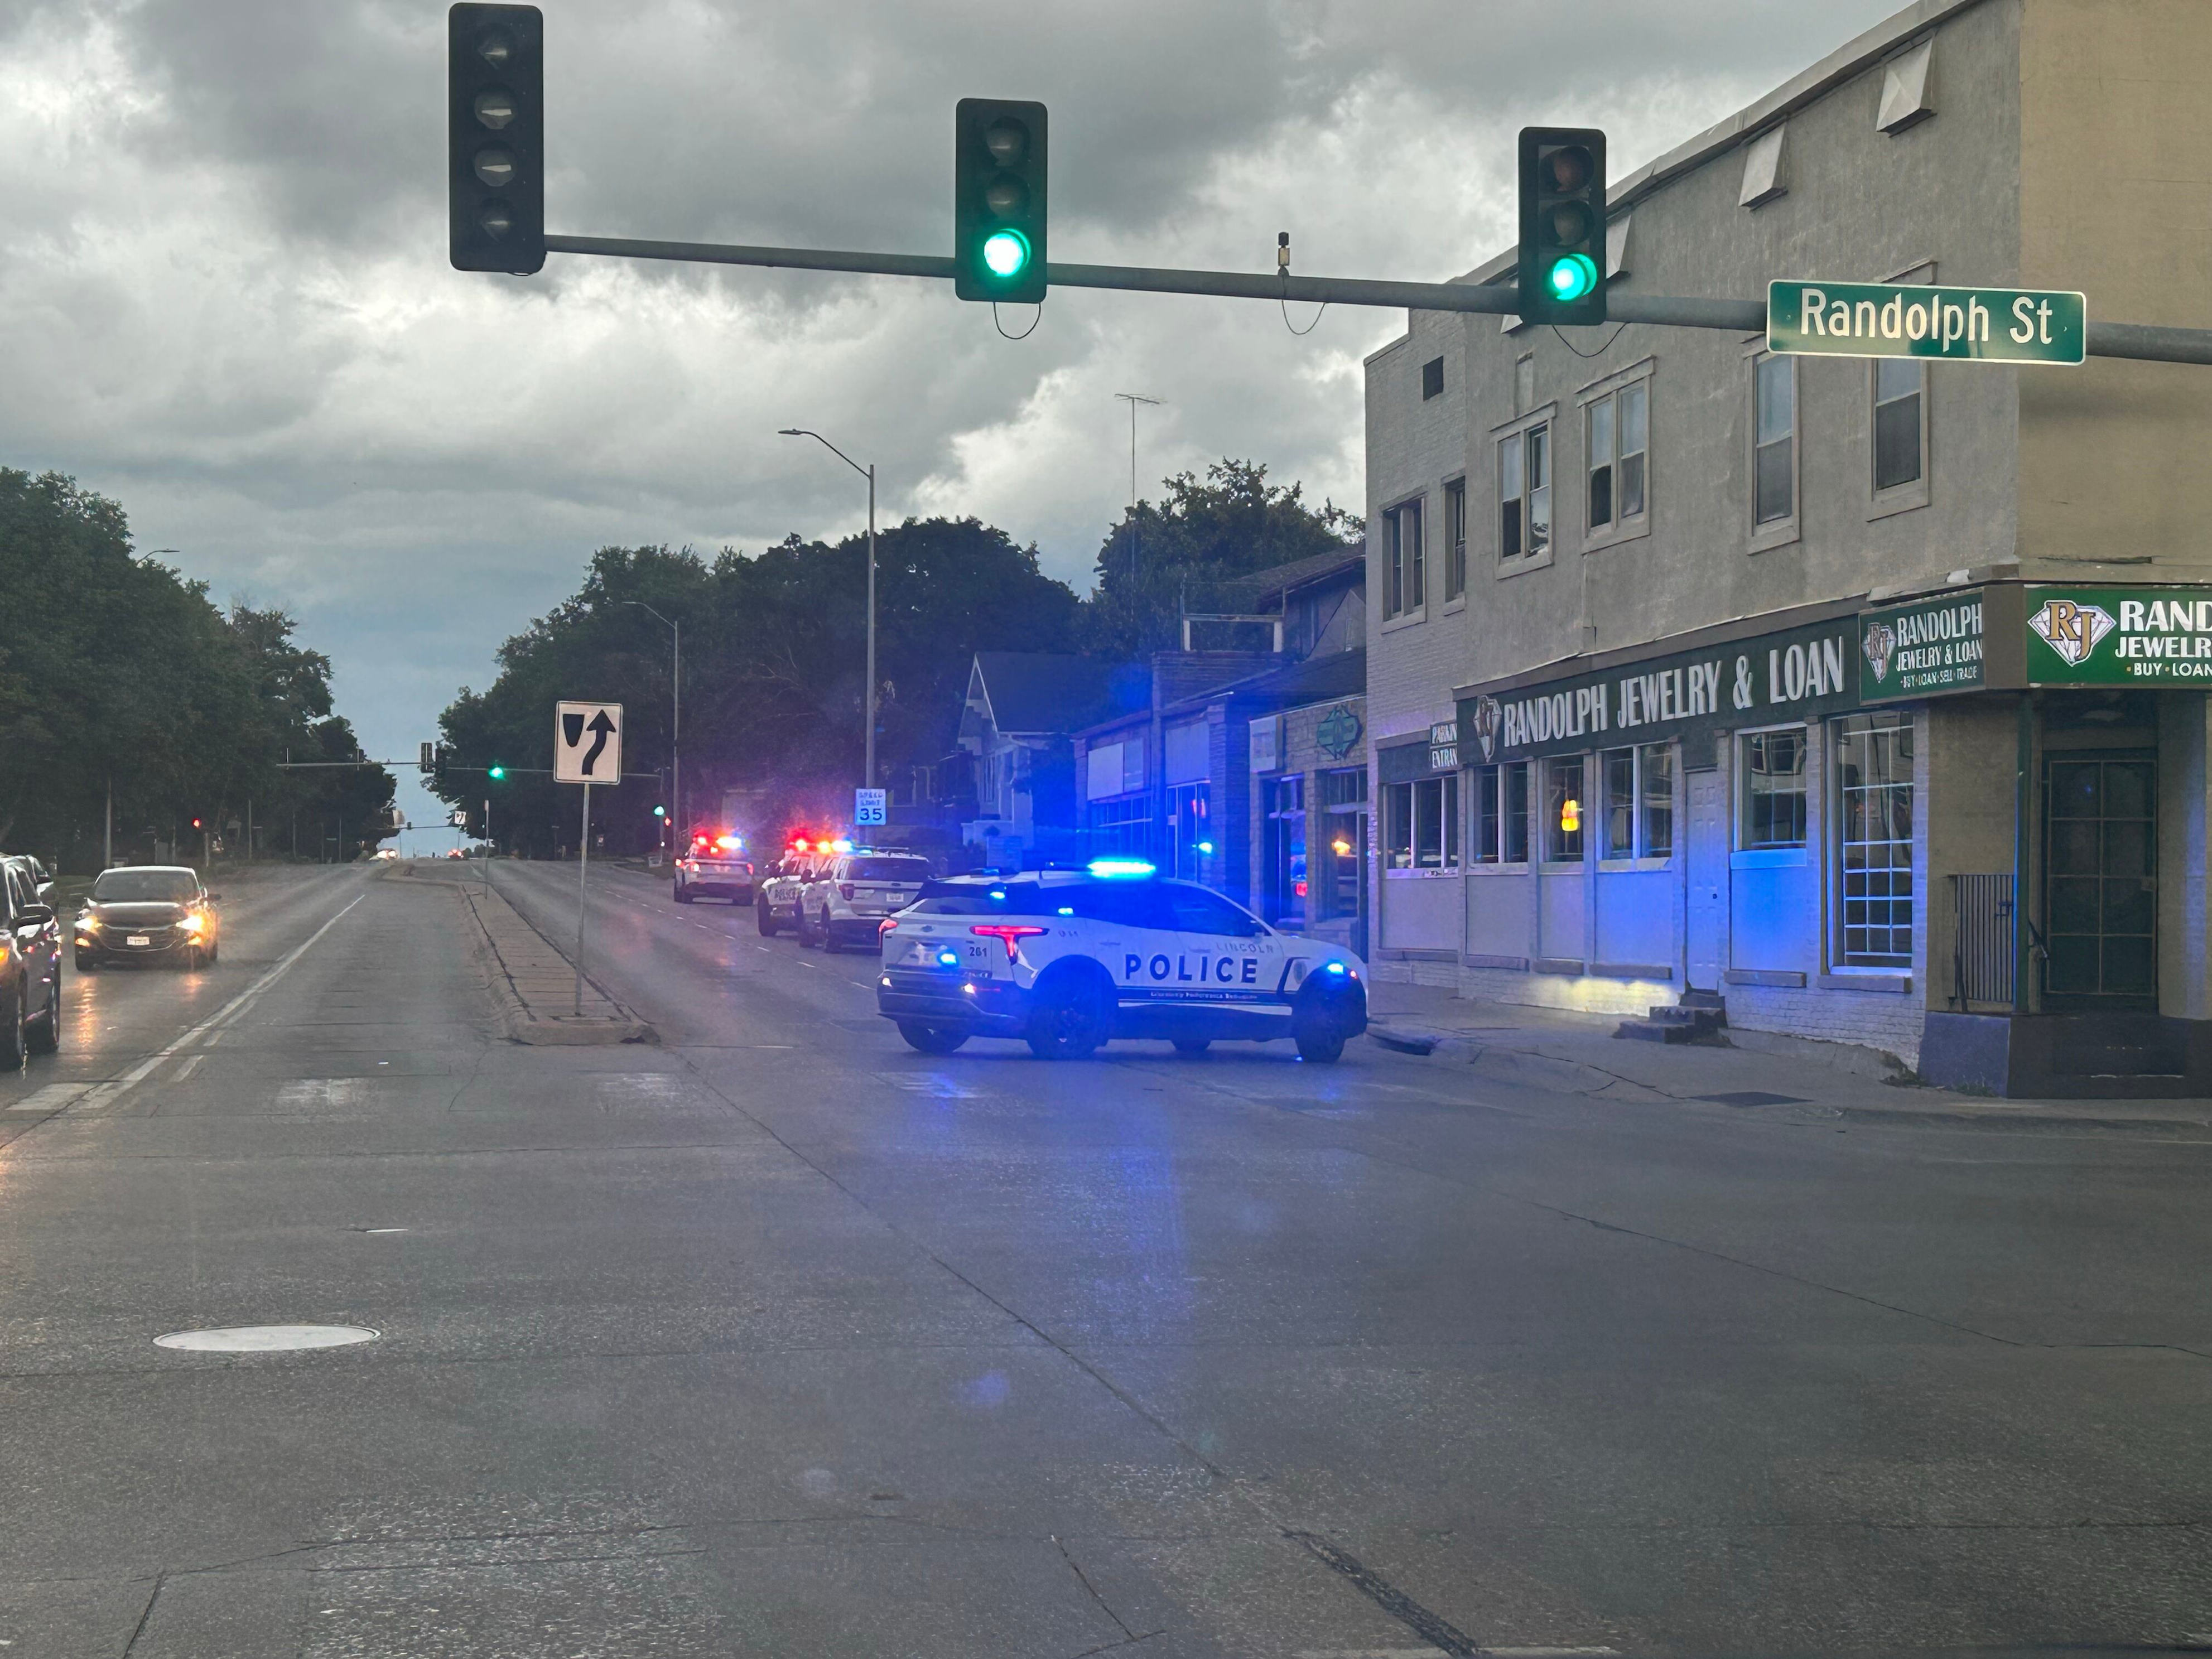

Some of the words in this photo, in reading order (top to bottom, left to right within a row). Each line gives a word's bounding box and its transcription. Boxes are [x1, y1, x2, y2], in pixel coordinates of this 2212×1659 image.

[1801, 288, 1989, 353] Randolph
[2009, 296, 2053, 345] St
[1897, 603, 1983, 647] RANDOLPH
[2046, 601, 2096, 660] RJ
[1896, 645, 1942, 672] JEWELRY
[1944, 644, 1953, 664] &
[1955, 639, 1983, 663] LOAN
[2134, 663, 2162, 676] BUY
[1504, 684, 1607, 747] RANDOLPH
[1617, 660, 1722, 729] JEWELRY
[1733, 655, 1753, 710] &
[1769, 635, 1845, 704] LOAN
[860, 808, 882, 821] 35
[1216, 942, 1274, 953] LINCOLN
[1125, 954, 1257, 983] POLICE
